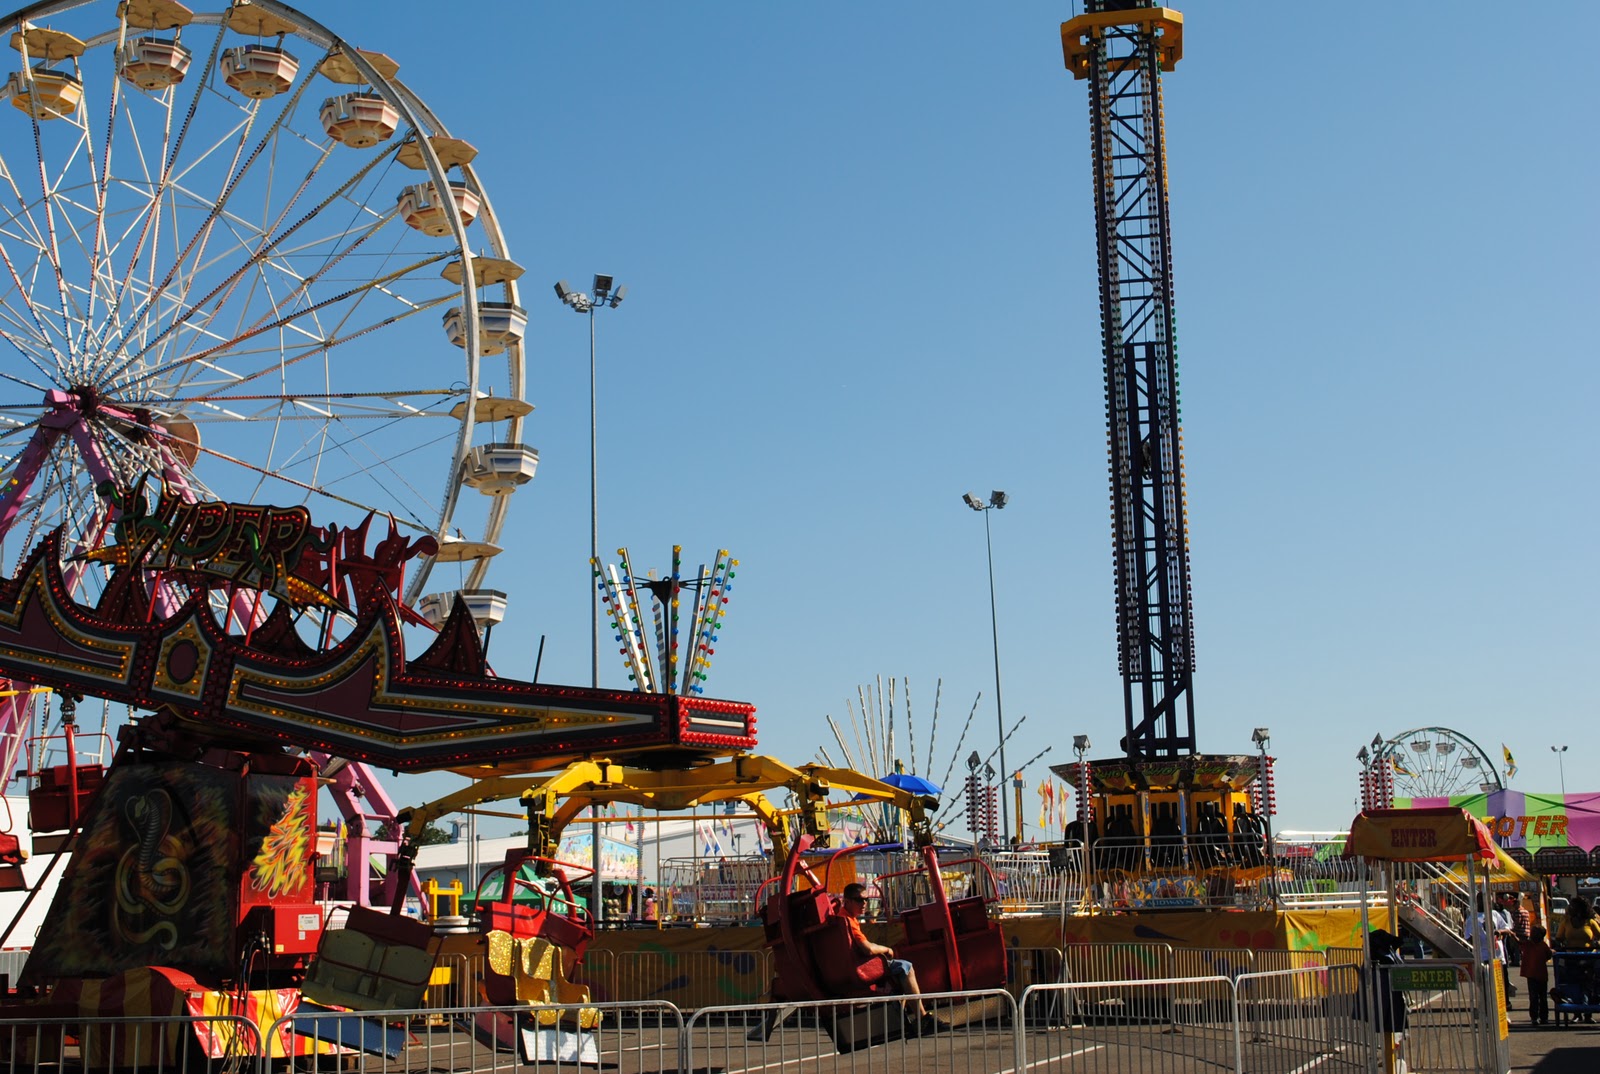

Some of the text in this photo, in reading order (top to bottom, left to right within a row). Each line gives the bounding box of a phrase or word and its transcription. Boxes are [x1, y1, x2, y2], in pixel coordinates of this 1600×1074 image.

[121, 470, 312, 606] VIPER
[1391, 829, 1437, 847] ENTER
[1411, 970, 1453, 982] ENTER
